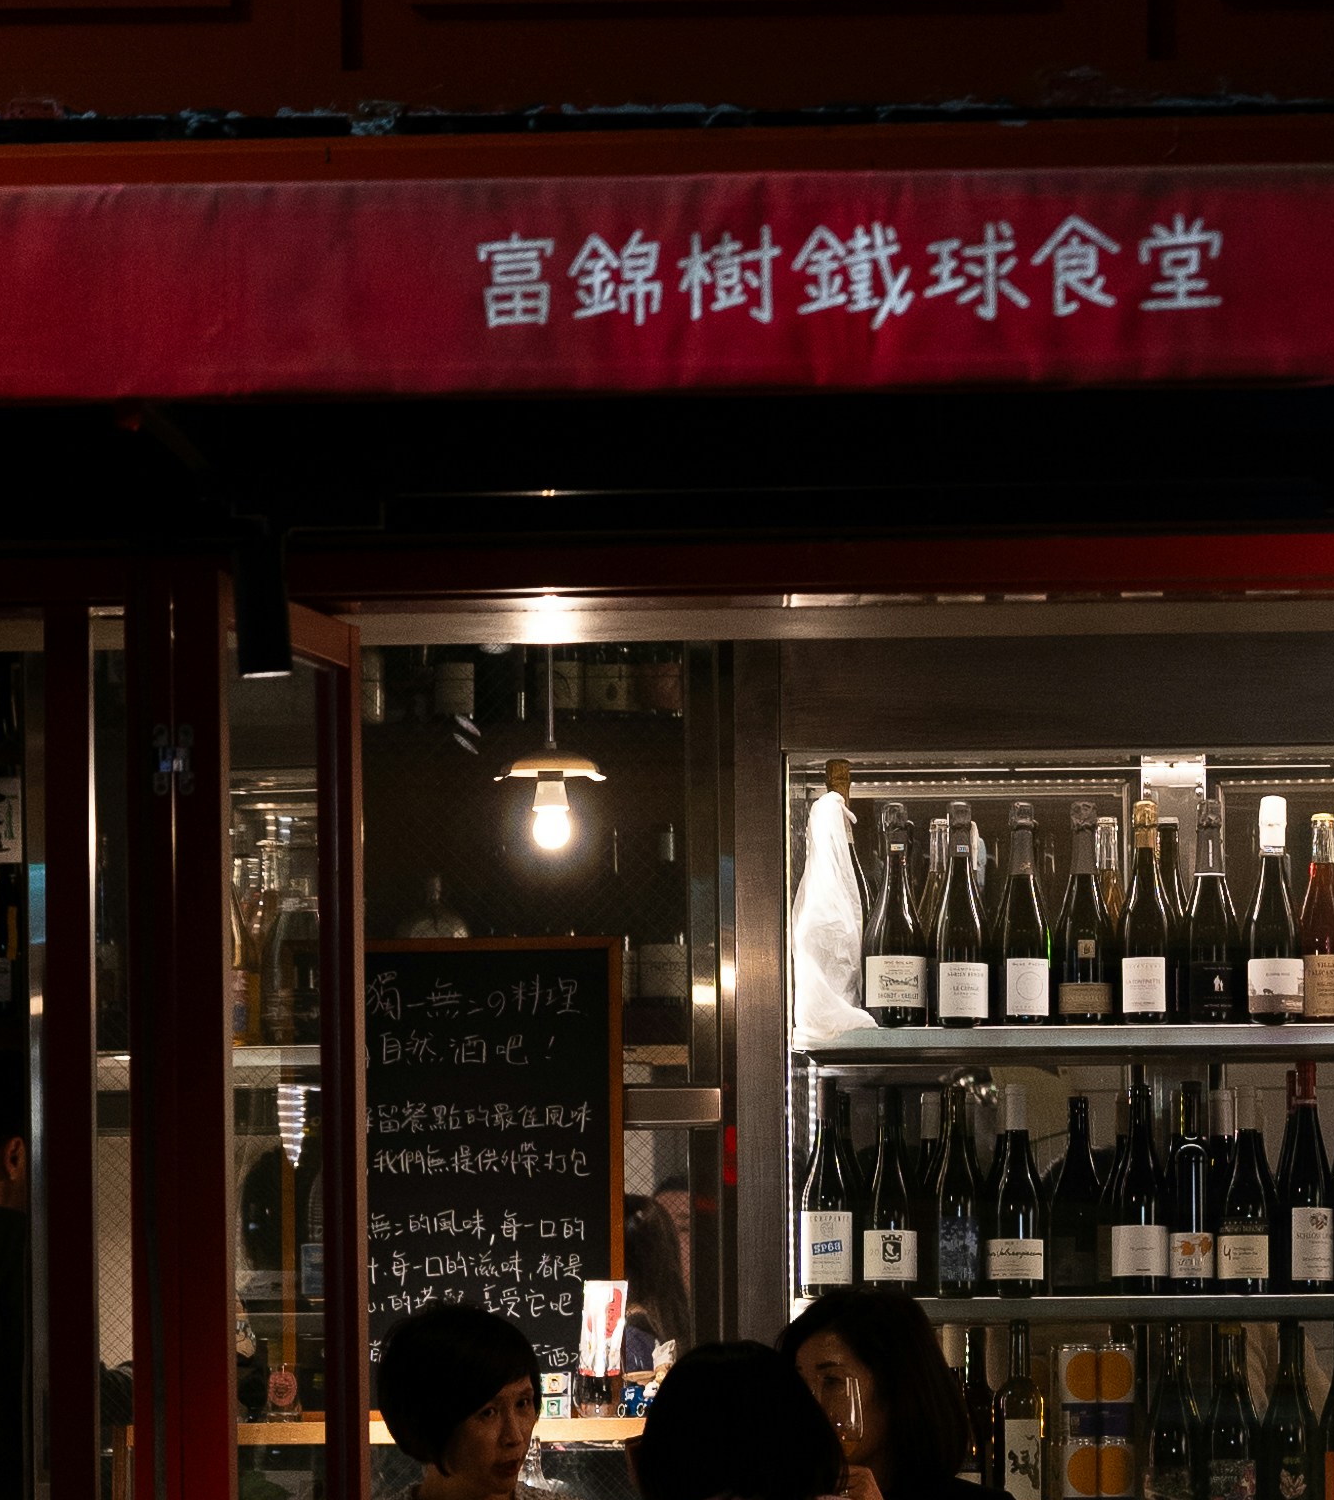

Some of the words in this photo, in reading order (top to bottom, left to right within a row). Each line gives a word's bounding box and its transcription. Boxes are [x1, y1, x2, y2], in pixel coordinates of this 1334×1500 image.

[475, 212, 1224, 329] 富錦樹鐵球食堂
[814, 1243, 843, 1254] SP68
